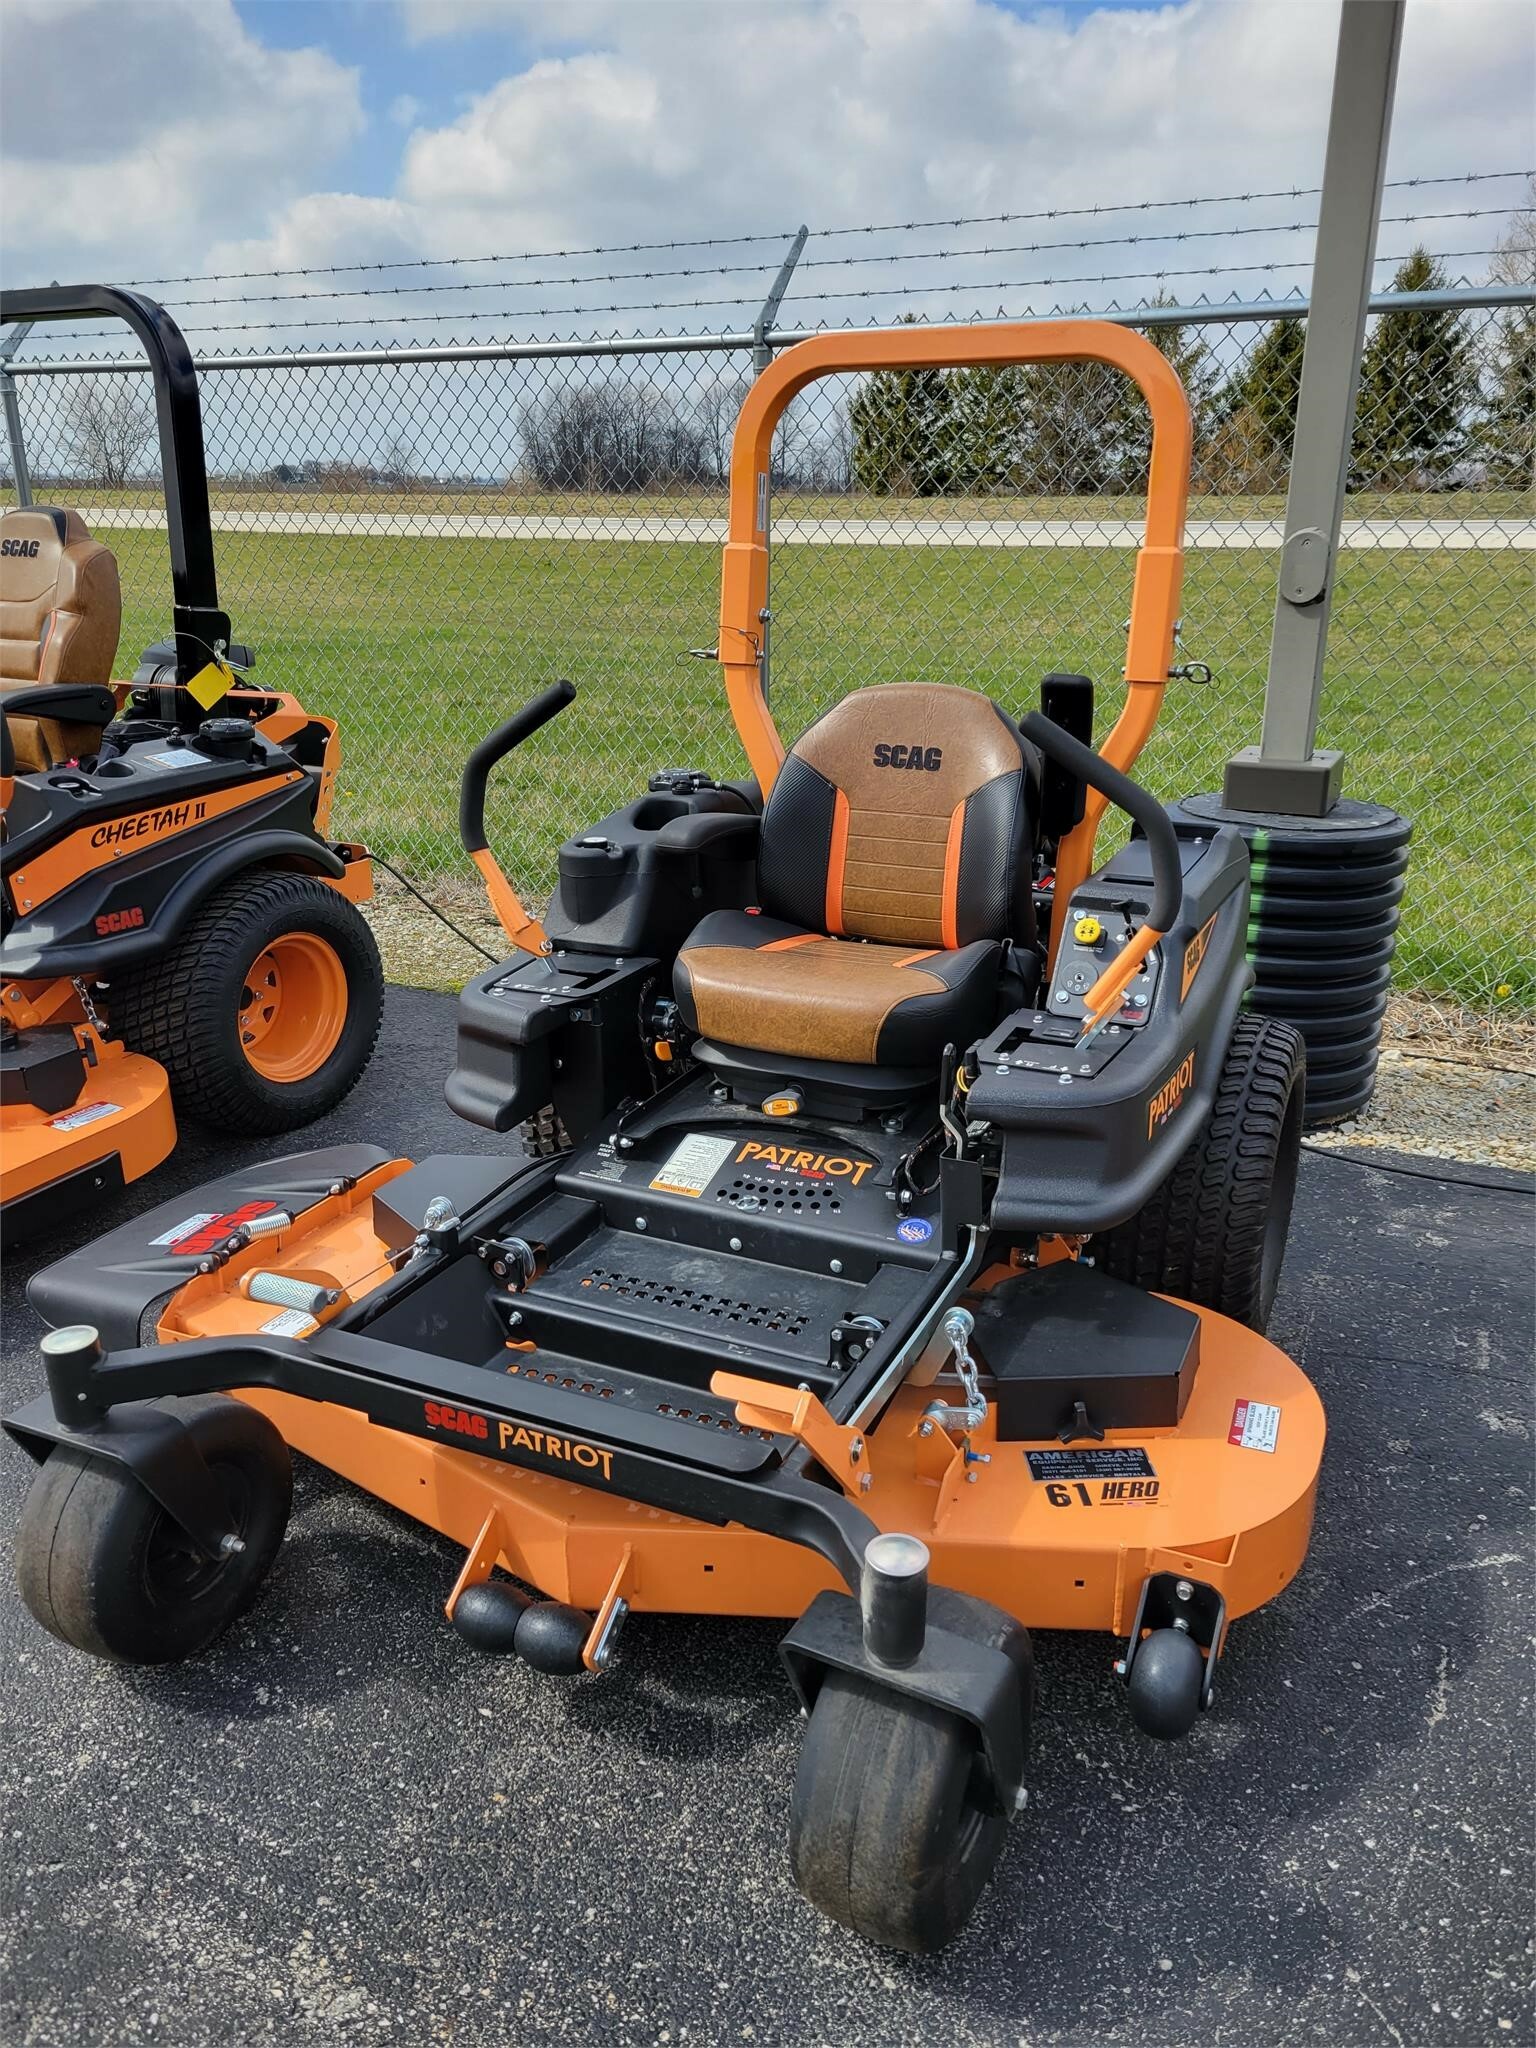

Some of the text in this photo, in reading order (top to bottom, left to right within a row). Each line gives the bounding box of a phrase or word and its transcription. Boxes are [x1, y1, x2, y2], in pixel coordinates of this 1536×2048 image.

[0, 538, 40, 558] SCAG
[873, 743, 943, 771] SCAG
[90, 801, 206, 849] CHEETAH II
[95, 906, 145, 936] SCAG
[1147, 1050, 1196, 1141] PATRIOT
[735, 1141, 873, 1186] PATRIOT
[904, 1224, 926, 1235] USA
[424, 1399, 614, 1481] SCAG PATRIOT
[1029, 1449, 1144, 1461] AMERICAN
[1045, 1480, 1160, 1508] 61 HERO
